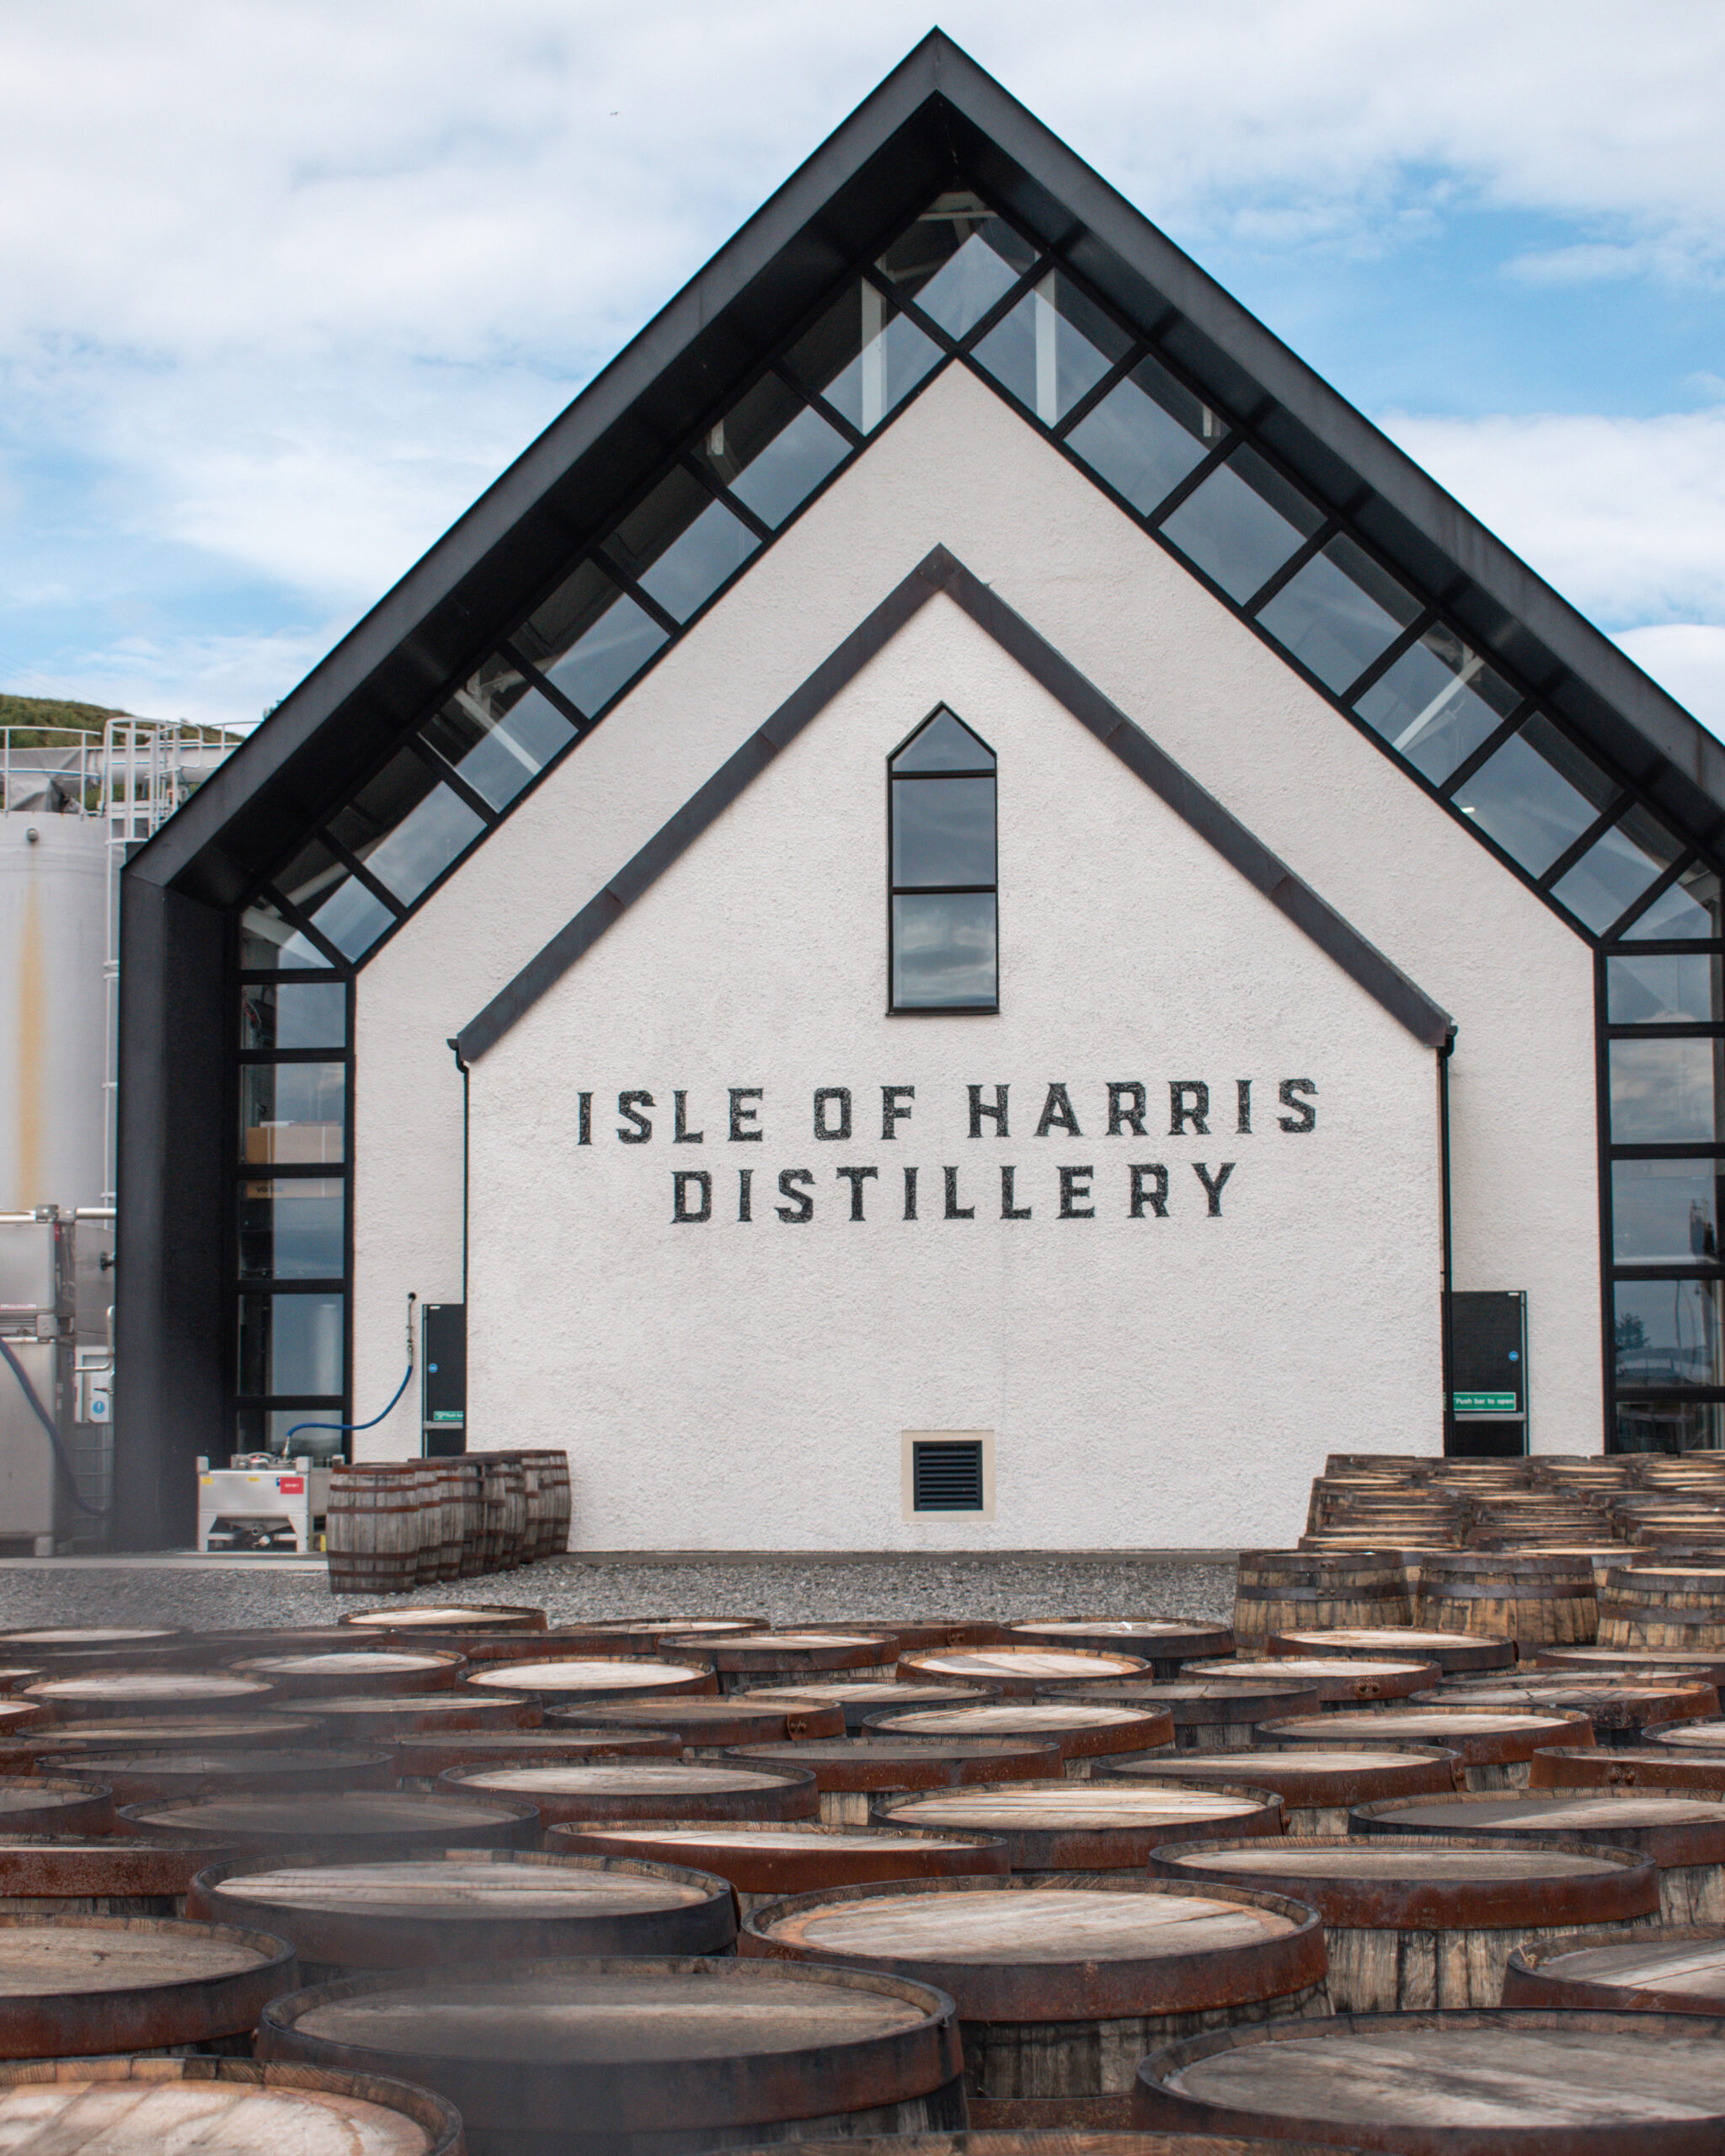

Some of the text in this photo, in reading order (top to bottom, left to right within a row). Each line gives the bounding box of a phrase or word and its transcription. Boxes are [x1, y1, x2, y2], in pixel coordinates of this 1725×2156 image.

[578, 1078, 1317, 1145] ISLE OF HARRIS
[670, 1162, 1236, 1224] DISTILLERY
